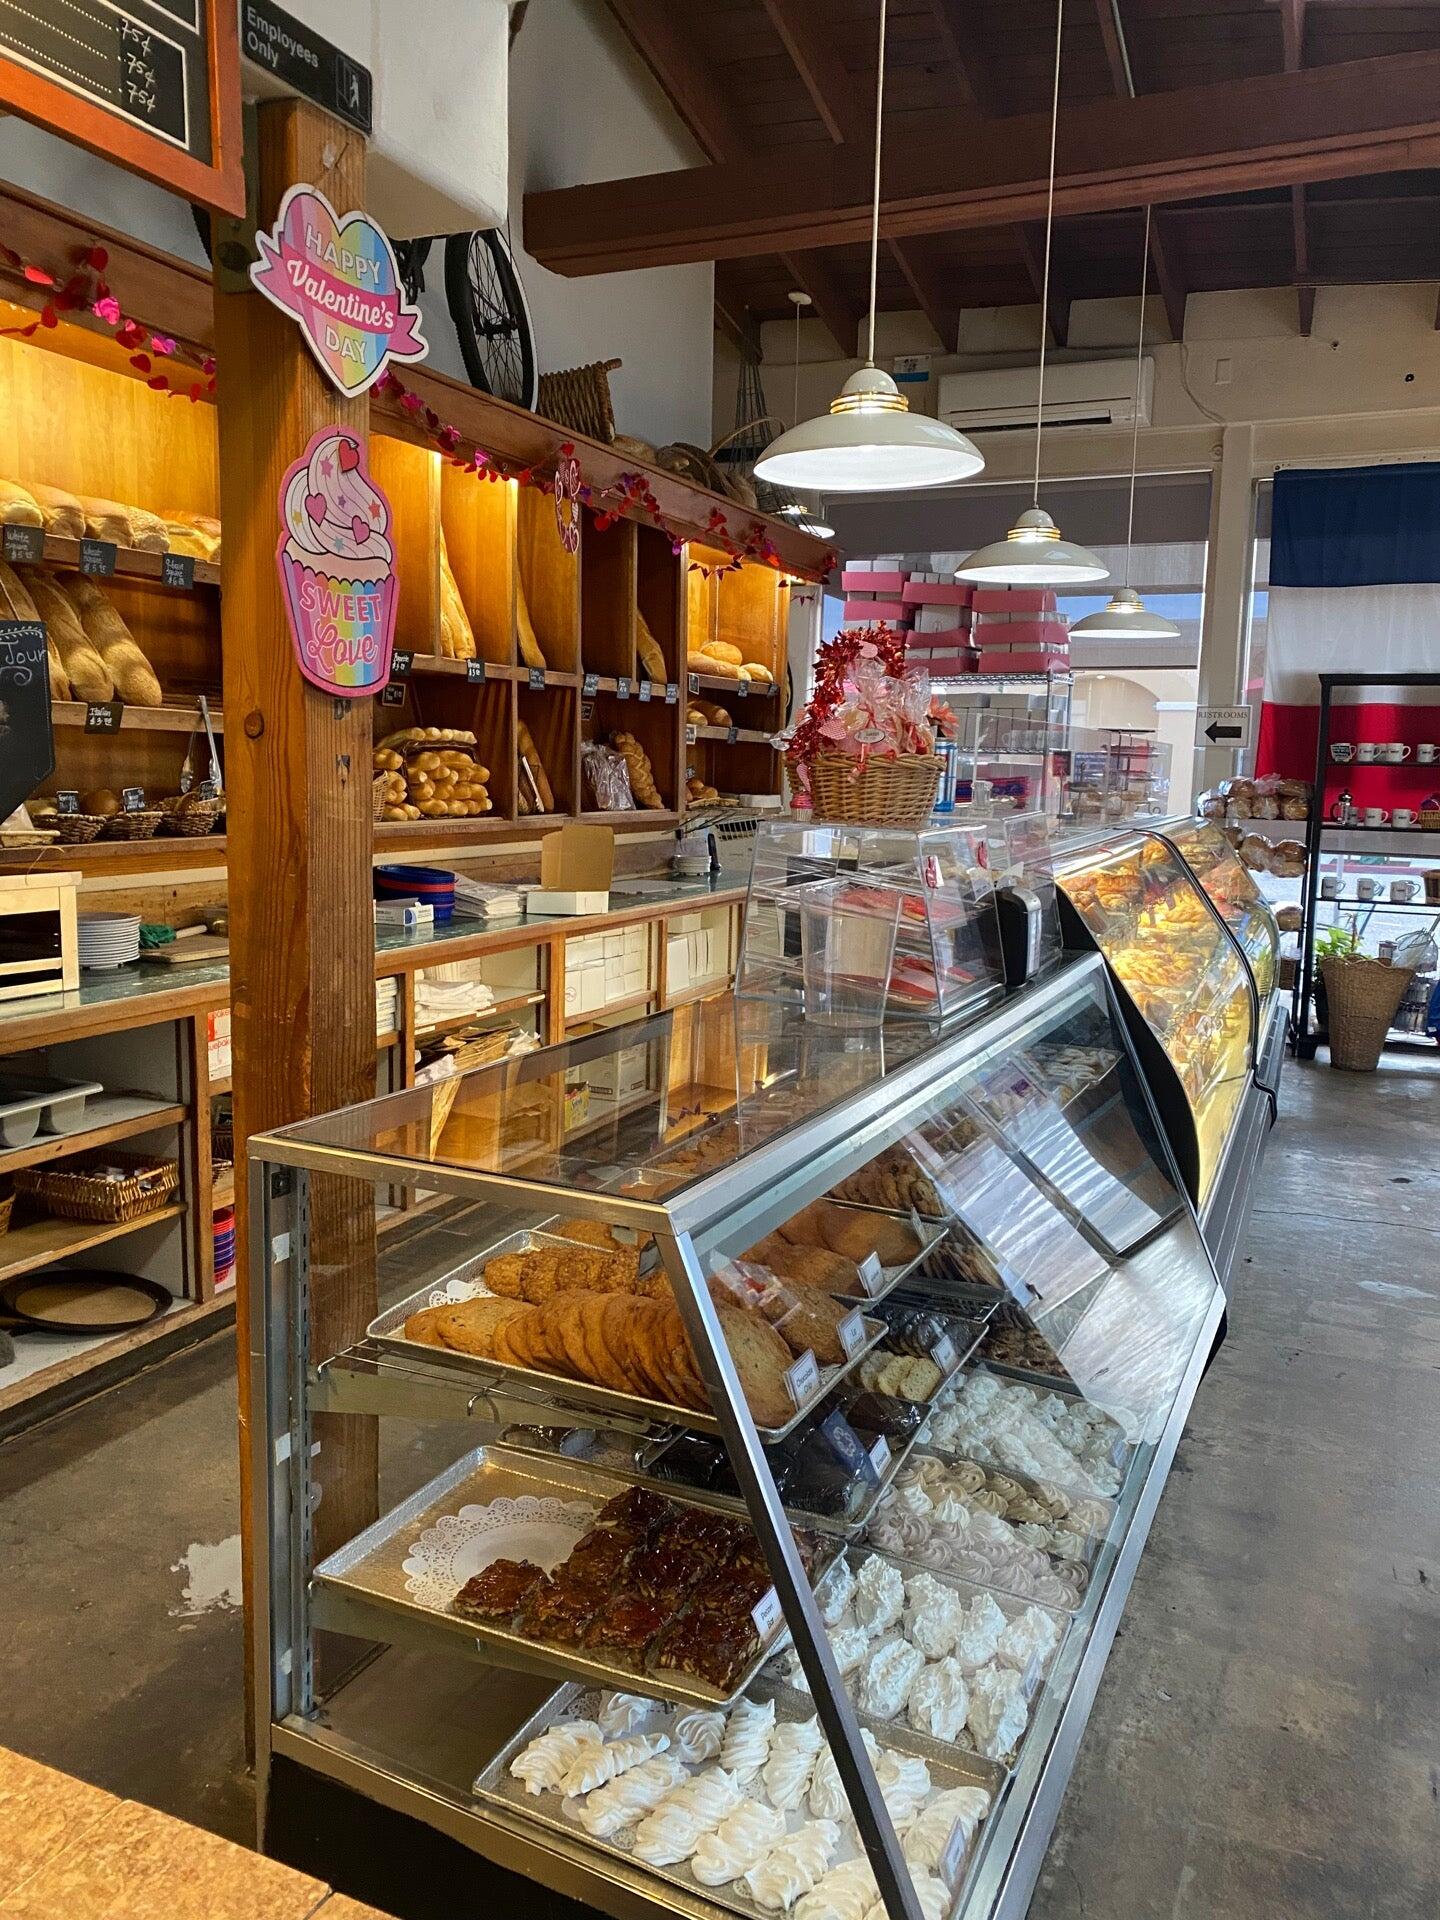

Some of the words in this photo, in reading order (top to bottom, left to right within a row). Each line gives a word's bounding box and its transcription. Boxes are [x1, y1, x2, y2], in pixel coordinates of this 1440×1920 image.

[247, 5, 319, 68] Employees
[247, 31, 278, 68] Only
[305, 222, 381, 285] HAPPY
[287, 259, 394, 329] Valentine's
[325, 325, 367, 365] DAY
[300, 580, 381, 622] SWEET
[3, 639, 46, 665] Jour
[307, 618, 378, 675] Love
